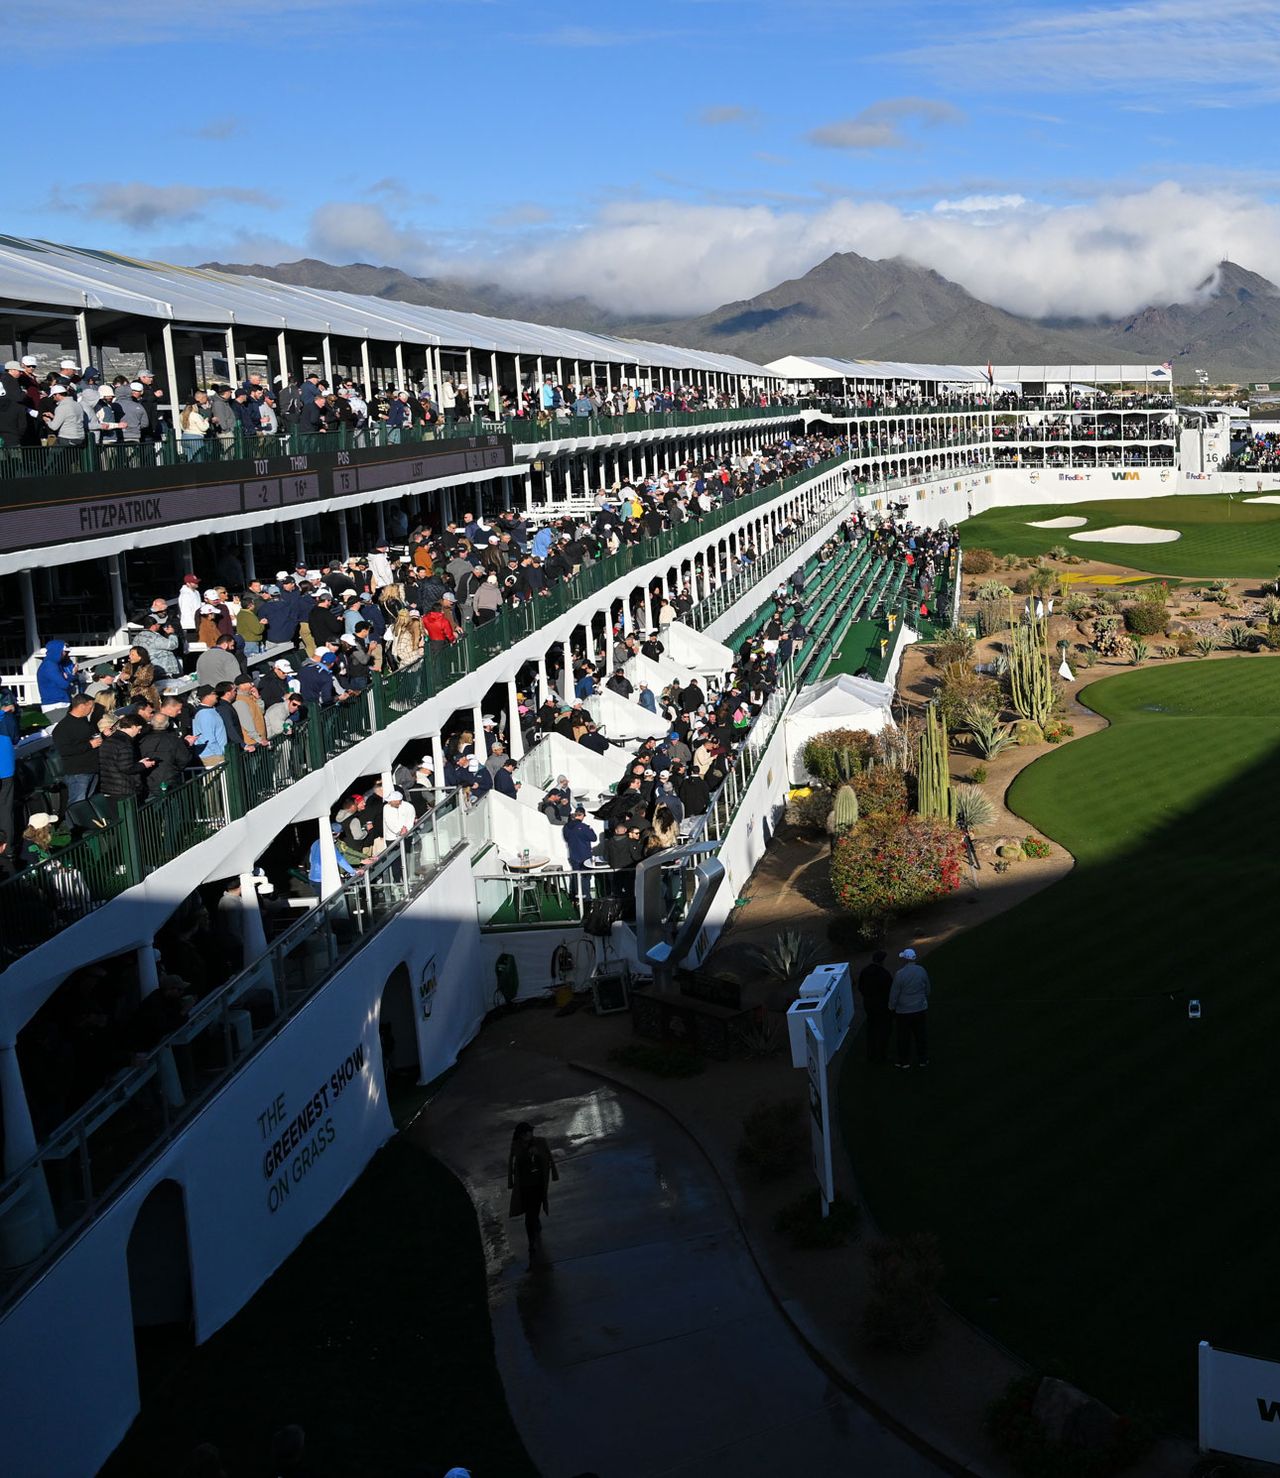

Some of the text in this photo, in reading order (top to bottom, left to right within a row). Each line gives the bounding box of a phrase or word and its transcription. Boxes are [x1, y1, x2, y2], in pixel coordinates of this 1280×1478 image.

[253, 455, 308, 476] TOT THRU
[336, 452, 351, 466] POS
[1206, 453, 1219, 463] 16
[340, 473, 351, 489] T5
[411, 462, 425, 477] LIST
[1064, 474, 1083, 482] FedEx
[1111, 471, 1140, 481] WM
[1190, 473, 1206, 481] FedEx
[79, 497, 163, 531] FITZPATRICK
[258, 485, 269, 503] -2
[257, 1091, 288, 1140] THE
[263, 1043, 365, 1179] GREENEST SHOW
[267, 1117, 338, 1215] ON GRASS
